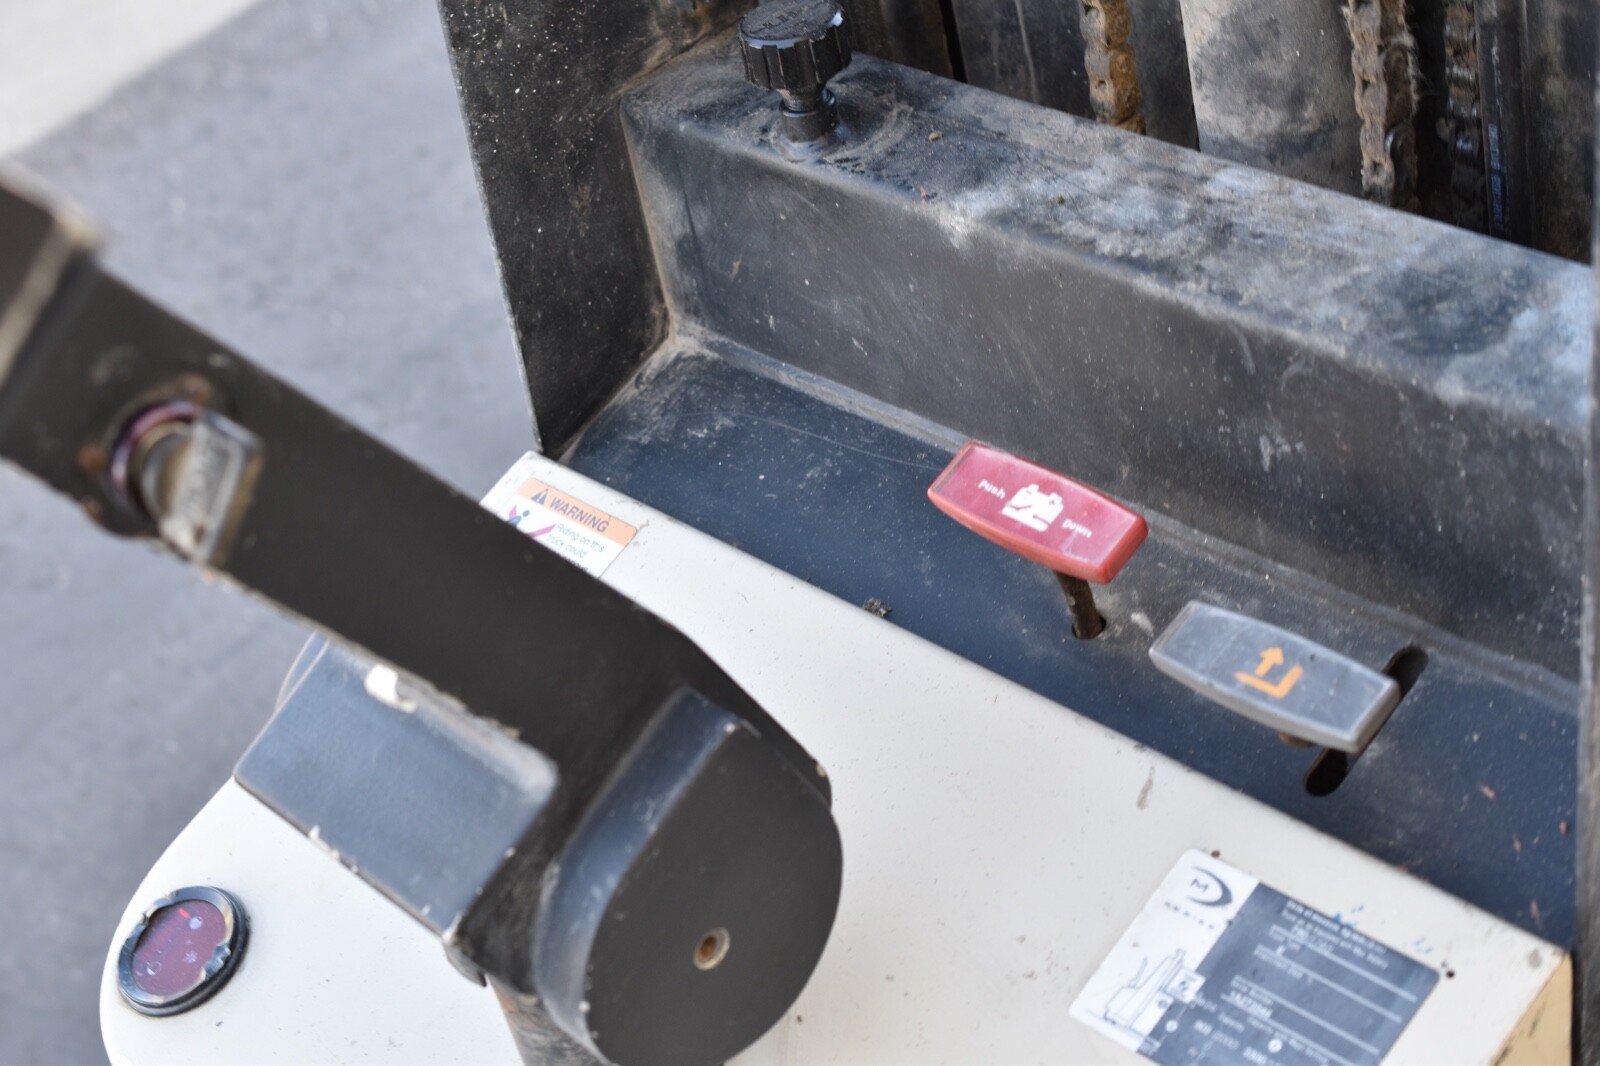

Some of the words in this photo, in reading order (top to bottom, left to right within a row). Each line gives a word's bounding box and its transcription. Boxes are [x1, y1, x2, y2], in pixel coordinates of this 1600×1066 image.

[978, 479, 1006, 499] Push
[550, 496, 609, 533] WARNING
[556, 523, 580, 541] Riding
[579, 536, 591, 546] on
[1061, 518, 1092, 538] Down
[565, 543, 588, 558] could
